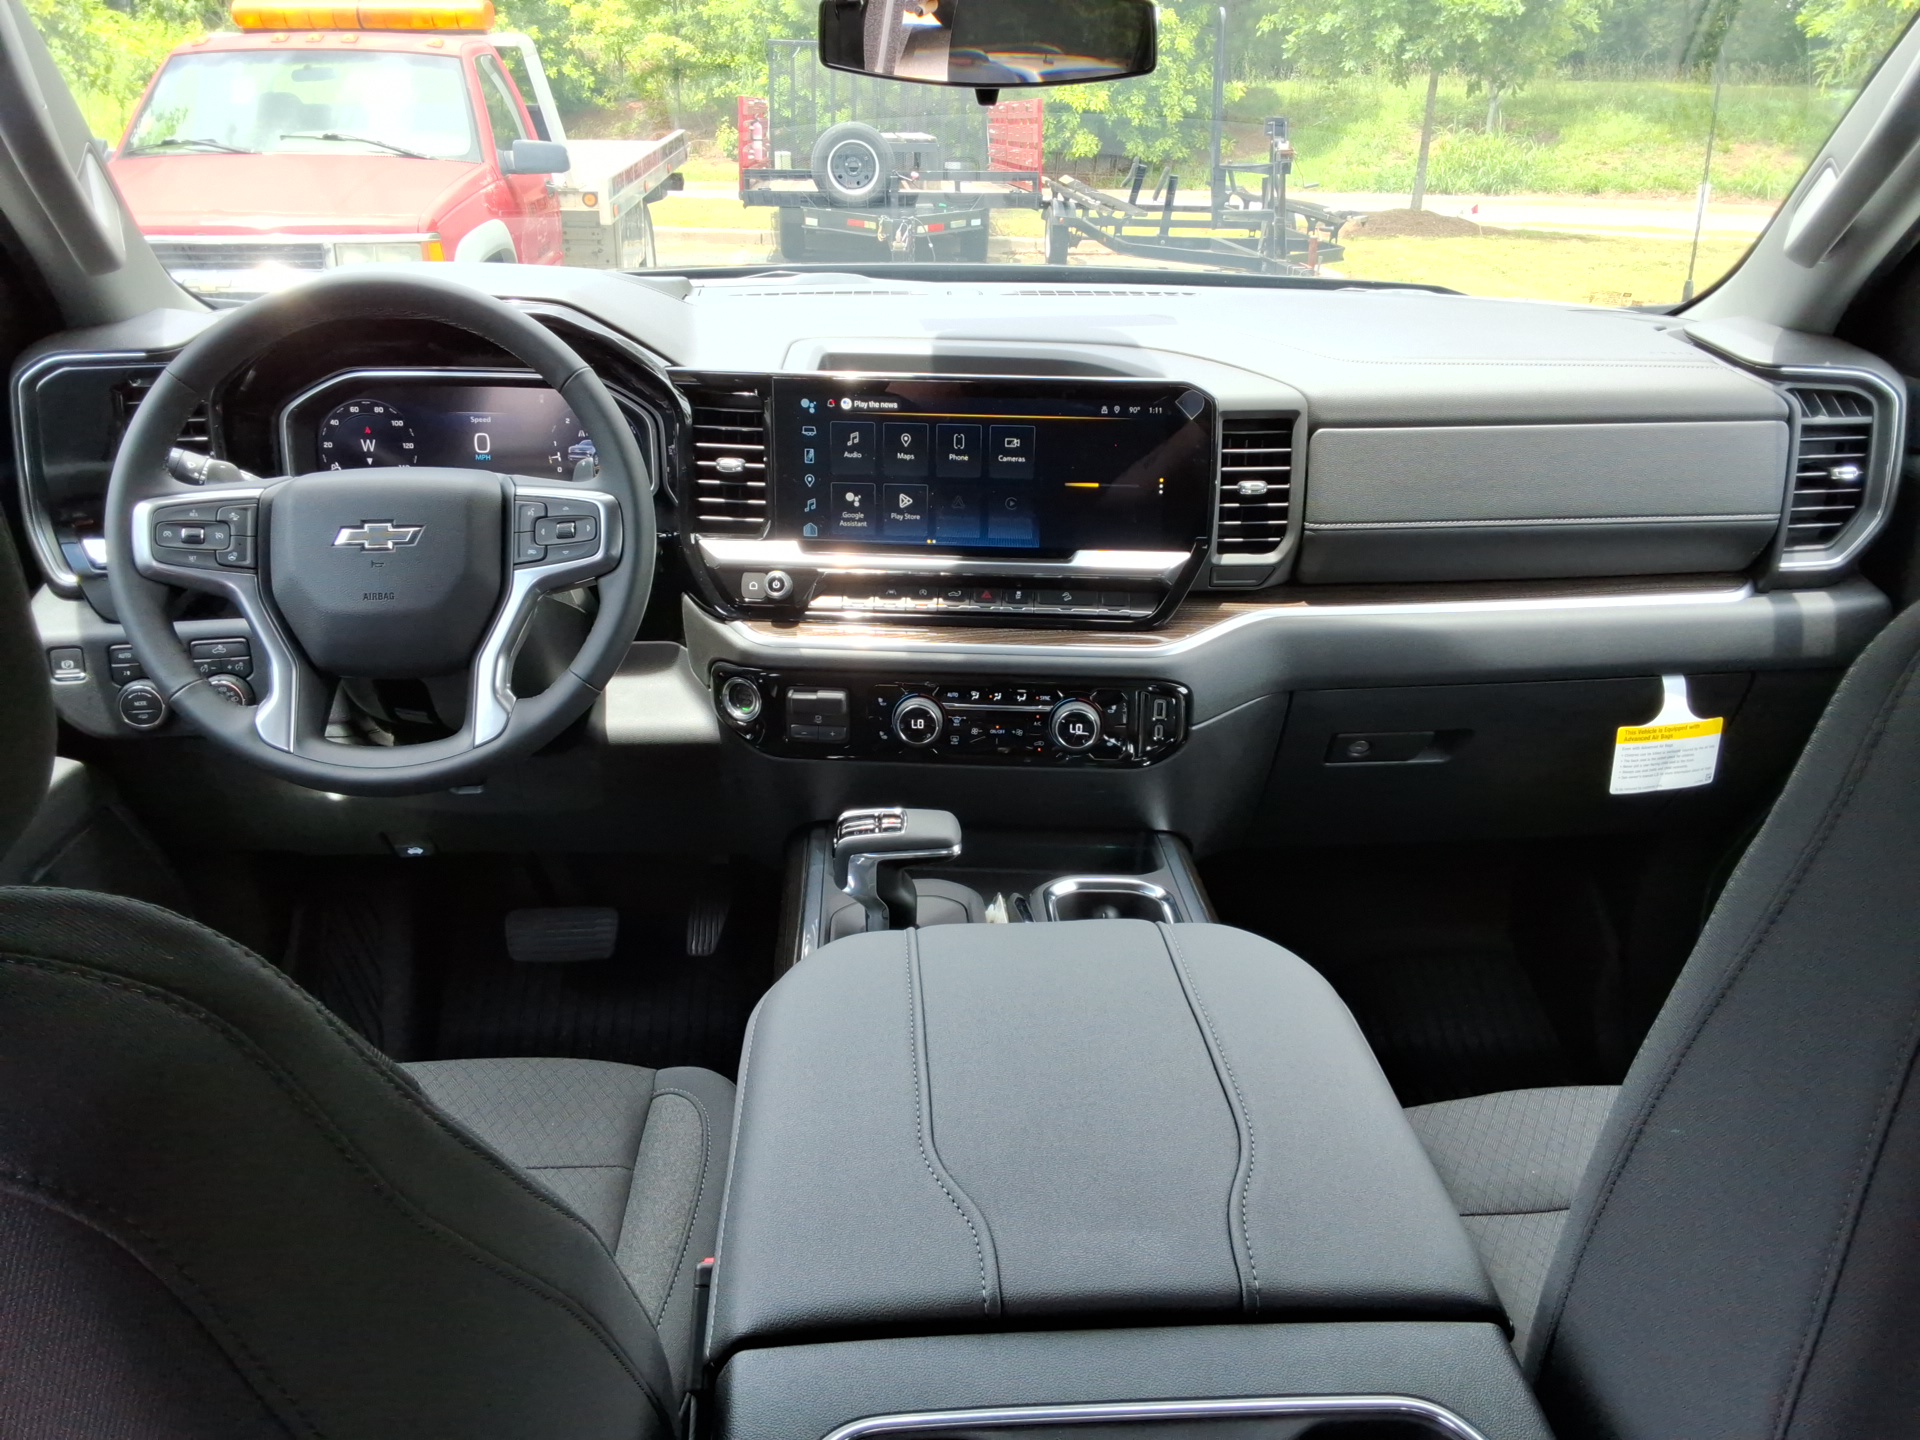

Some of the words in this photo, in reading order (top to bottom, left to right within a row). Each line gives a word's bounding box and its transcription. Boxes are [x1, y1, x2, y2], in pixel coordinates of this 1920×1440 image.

[854, 400, 867, 409] Play
[869, 400, 879, 408] the
[360, 439, 376, 452] W
[474, 432, 491, 453] 0
[897, 452, 915, 461] Maps
[948, 453, 969, 461] Phone
[997, 454, 1026, 463] Cameras
[842, 511, 864, 519] Google
[890, 512, 903, 521] Play
[362, 592, 395, 601] AIRBAG
[1664, 725, 1688, 733] Equipped
